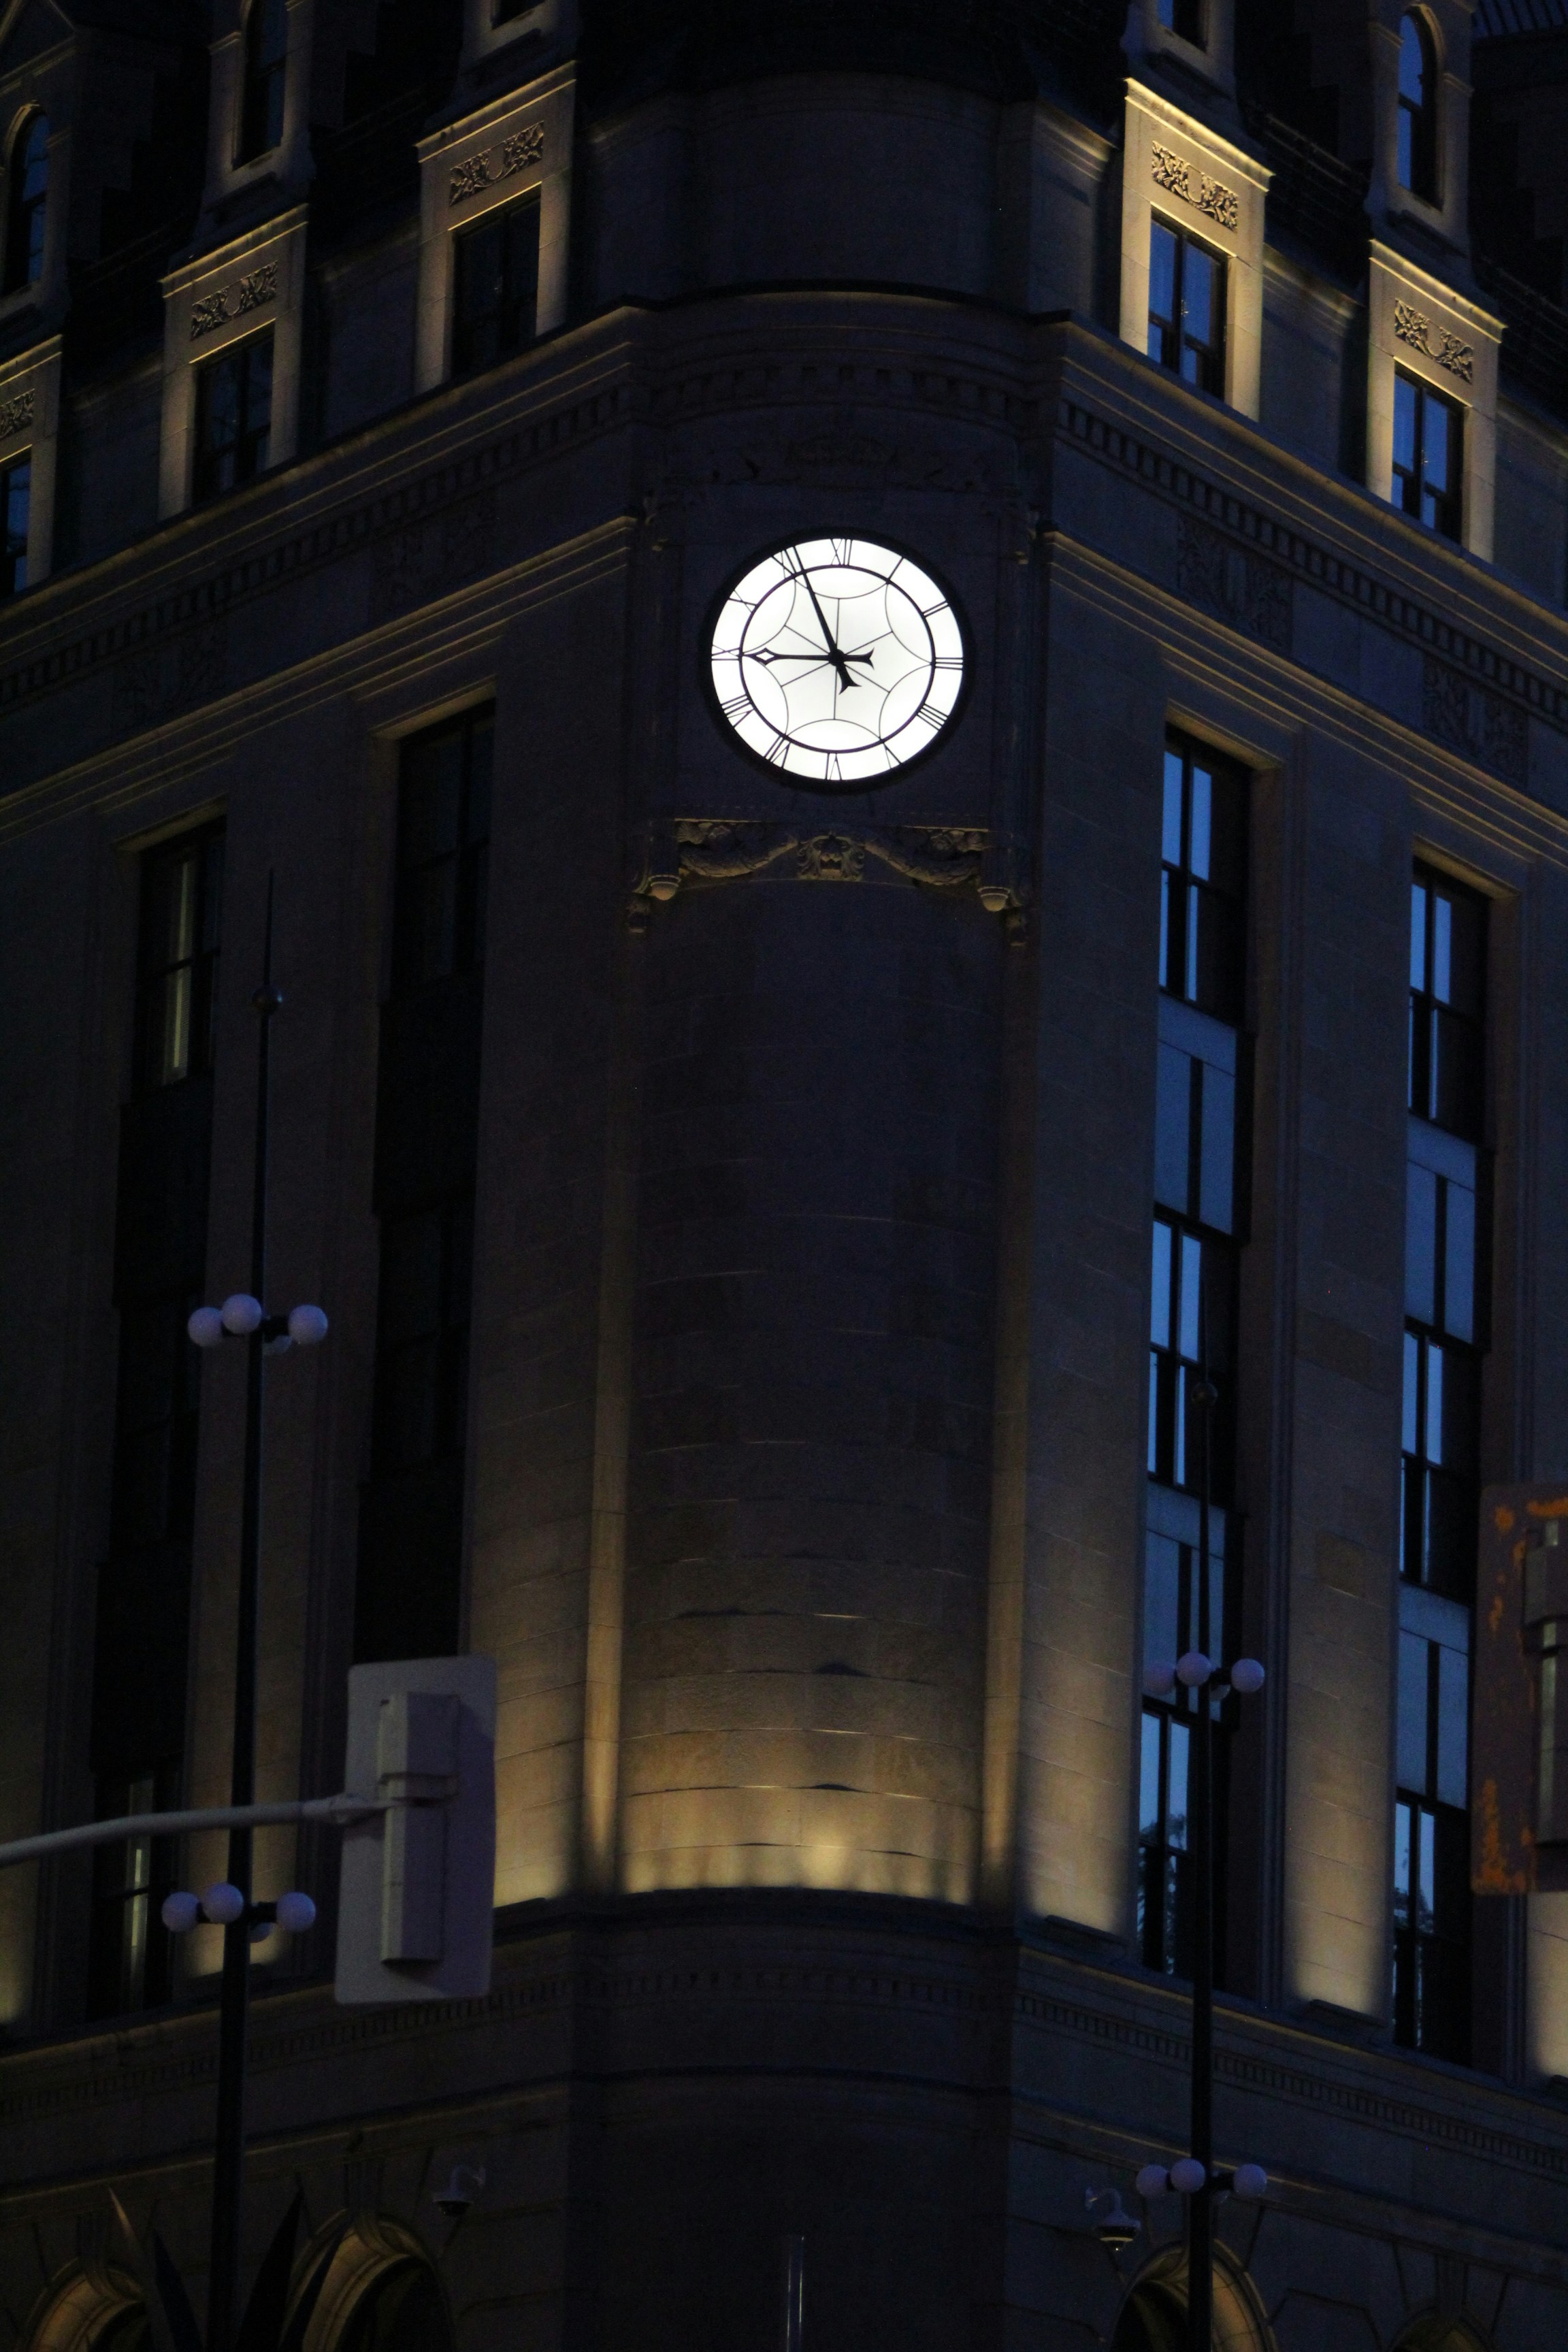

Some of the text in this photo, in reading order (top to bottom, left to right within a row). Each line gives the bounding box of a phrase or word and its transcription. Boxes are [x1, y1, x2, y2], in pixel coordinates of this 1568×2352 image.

[771, 549, 796, 578] XI
[830, 538, 853, 566] XII
[888, 557, 904, 580] I
[730, 589, 756, 612] X
[922, 601, 949, 617] II
[712, 644, 742, 660] IX
[934, 657, 963, 670] III
[722, 694, 753, 728] VIII
[917, 704, 947, 731] IIII
[765, 736, 790, 768] VII
[883, 742, 902, 768] V
[826, 752, 843, 780] VI
